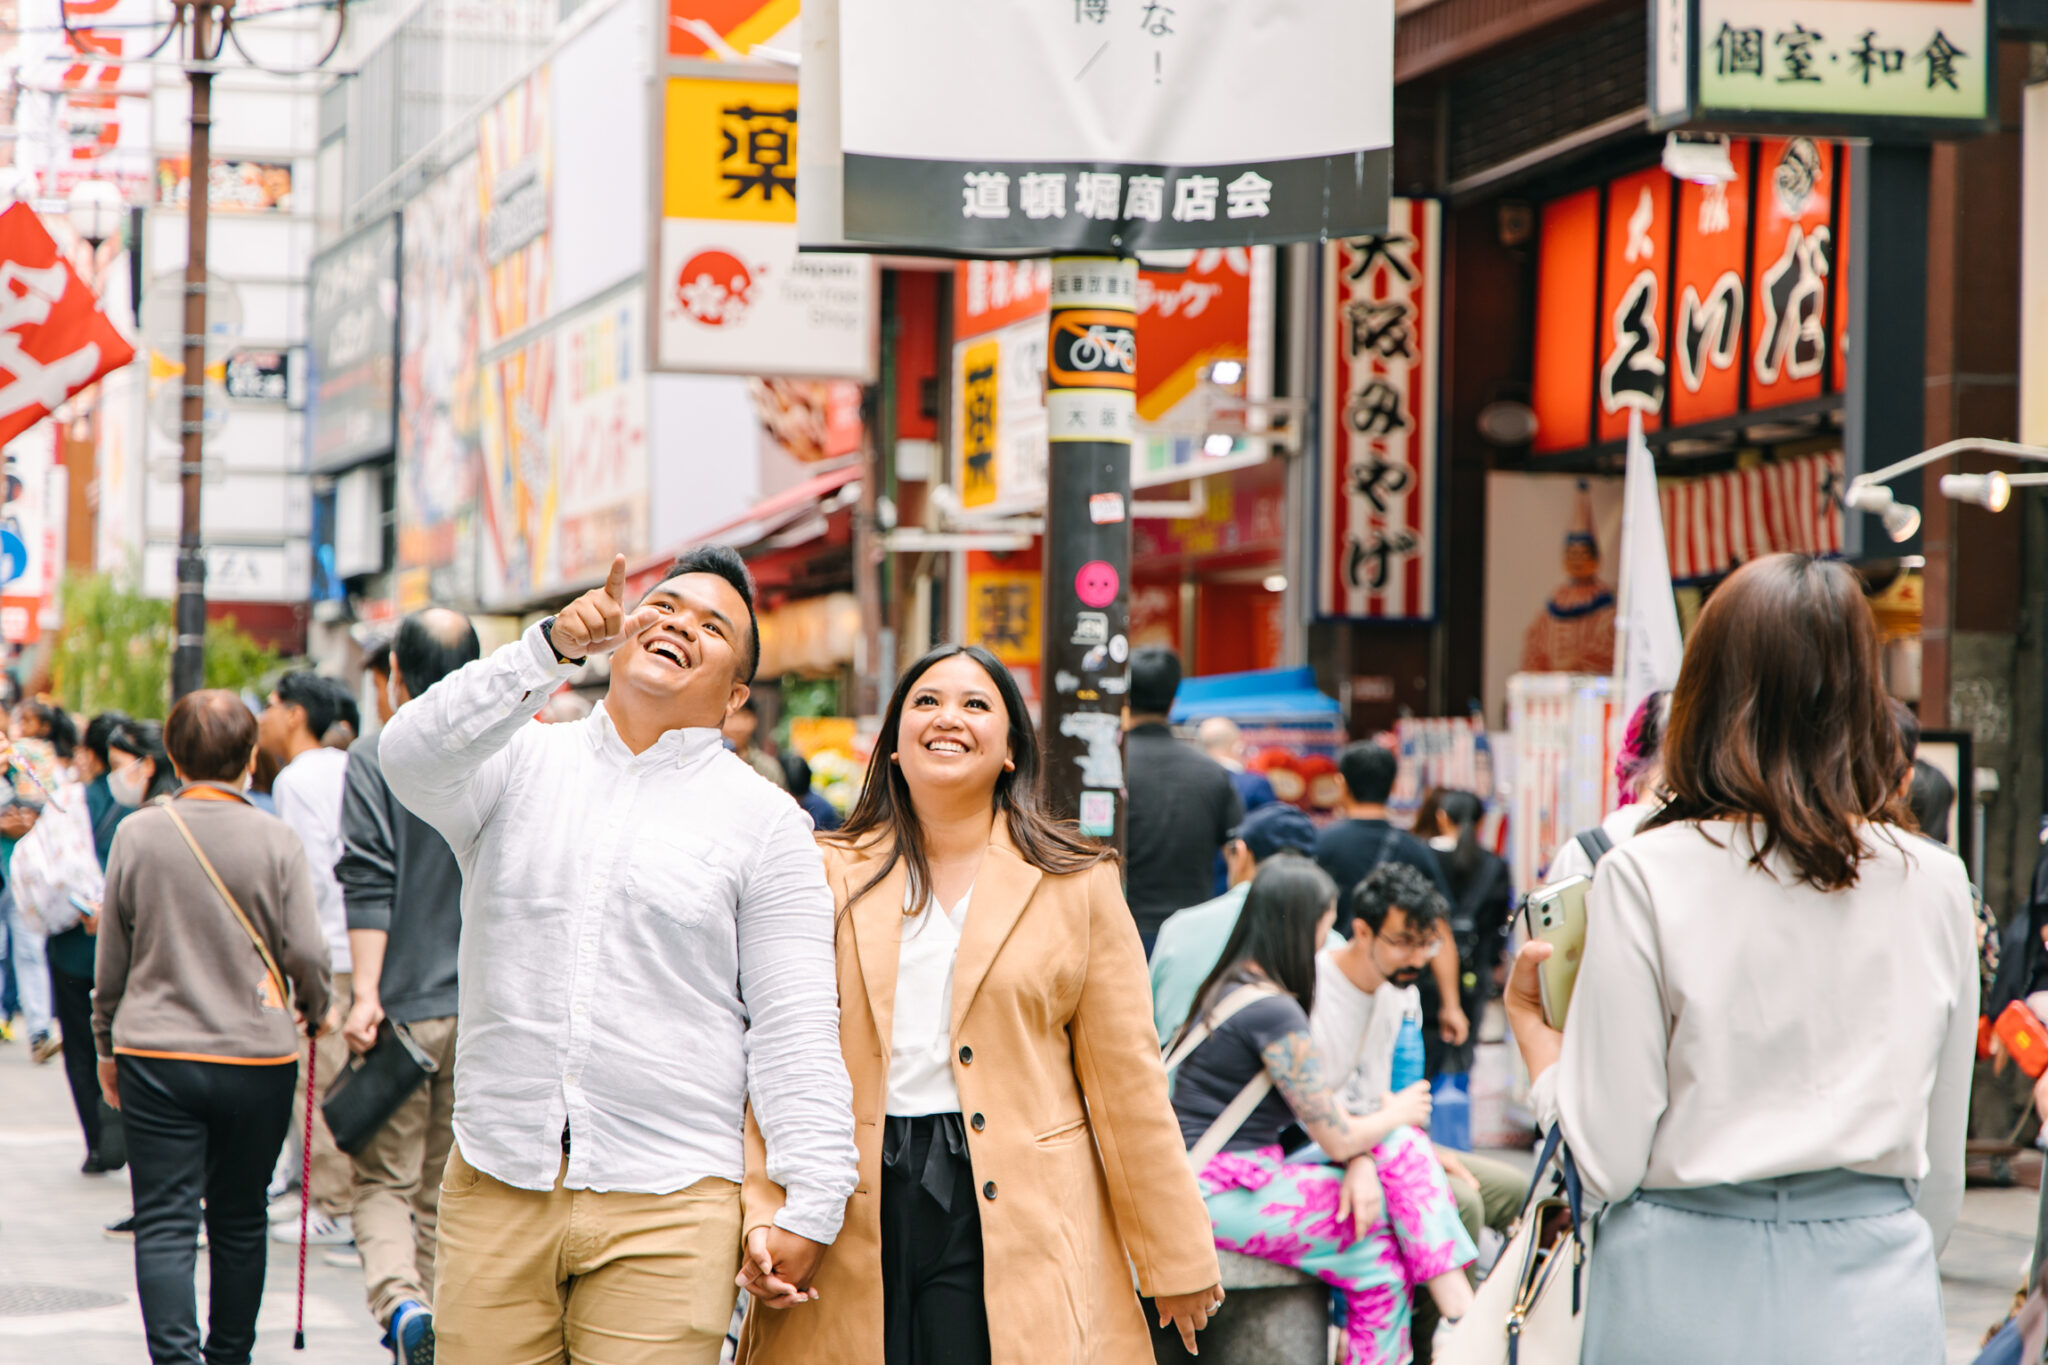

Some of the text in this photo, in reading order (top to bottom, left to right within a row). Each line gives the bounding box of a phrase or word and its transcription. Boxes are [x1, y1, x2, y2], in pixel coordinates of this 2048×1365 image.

[1711, 21, 1968, 91] 個室・和食
[961, 170, 1273, 222] 道頓堀商店会
